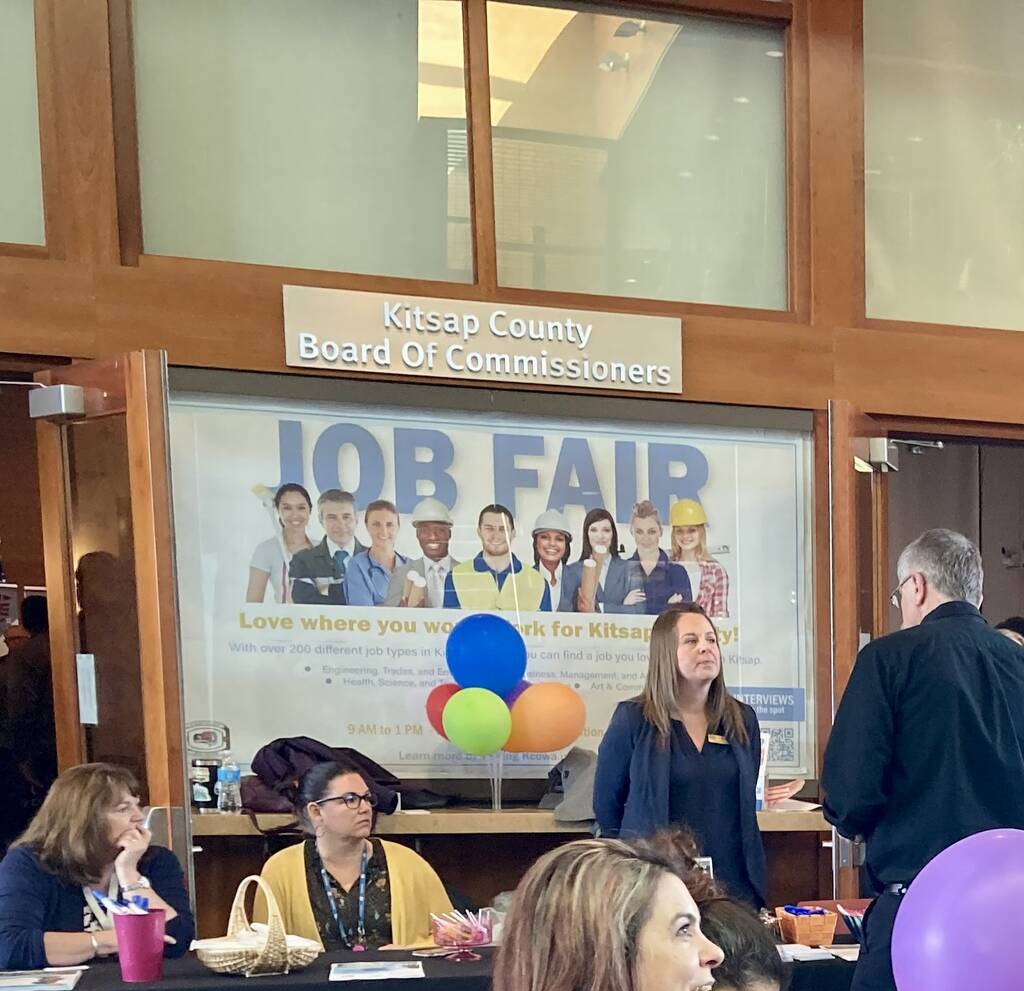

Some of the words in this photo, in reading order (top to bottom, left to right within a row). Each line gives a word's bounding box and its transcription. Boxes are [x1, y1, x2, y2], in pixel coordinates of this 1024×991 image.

[382, 302, 480, 340] Kitsap
[488, 310, 593, 348] County
[298, 332, 391, 366] Board
[401, 341, 438, 368] Of
[445, 344, 671, 386] Commissioners
[272, 419, 459, 515] JOB
[492, 433, 709, 524] FAIR
[239, 612, 294, 630] Love
[301, 614, 371, 633] where
[378, 619, 416, 636] you
[424, 619, 454, 634] wo
[551, 620, 583, 637] for
[588, 622, 653, 643] Kitsap
[227, 641, 257, 653] With
[260, 644, 287, 654] over
[289, 644, 312, 654] 200
[314, 644, 362, 656] different
[365, 646, 383, 658] job
[386, 646, 417, 659] types
[421, 647, 431, 657] in
[540, 651, 560, 660] can
[563, 649, 584, 660] find
[585, 652, 593, 660] a
[595, 651, 612, 662] job
[615, 652, 634, 663] you
[418, 667, 434, 676] and
[347, 723, 354, 735] 9
[359, 723, 377, 736] AM
[380, 725, 391, 736] to
[405, 723, 423, 736] PM
